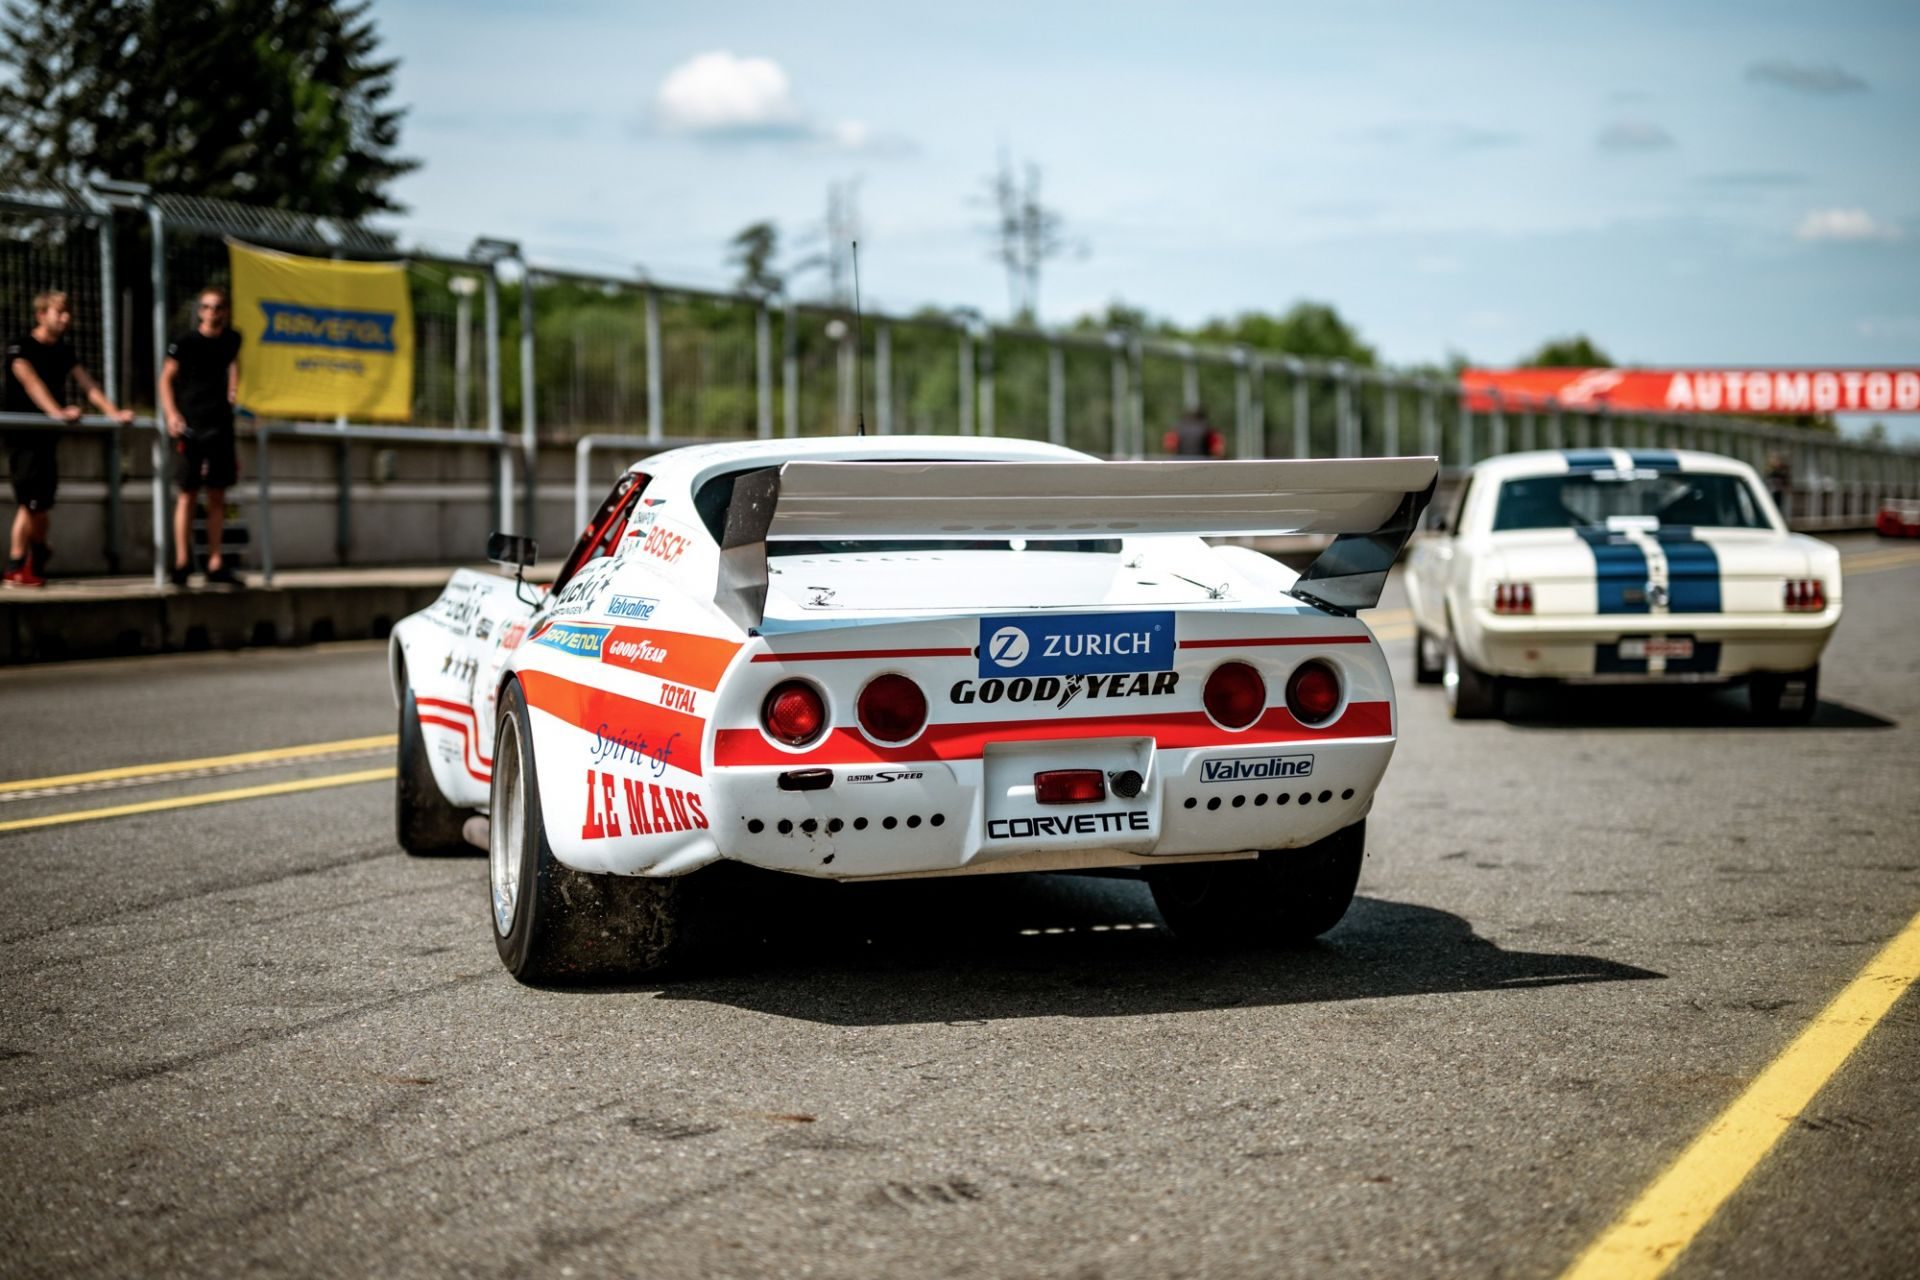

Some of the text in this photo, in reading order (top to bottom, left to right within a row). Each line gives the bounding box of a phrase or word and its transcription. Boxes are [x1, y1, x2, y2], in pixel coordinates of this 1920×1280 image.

[273, 311, 386, 344] RAVENOL
[643, 526, 691, 563] BOSCH
[607, 596, 656, 619] Valvoline
[543, 629, 603, 651] RAVENOL
[1042, 632, 1151, 657] ZURICH
[660, 683, 697, 713] TOTAL
[590, 723, 682, 778] Spirit of
[847, 771, 923, 783] CUSTOM SPEED
[1204, 756, 1312, 780] Valvoline
[582, 769, 709, 840] LE MANS
[987, 811, 1150, 839] CORVETTE
